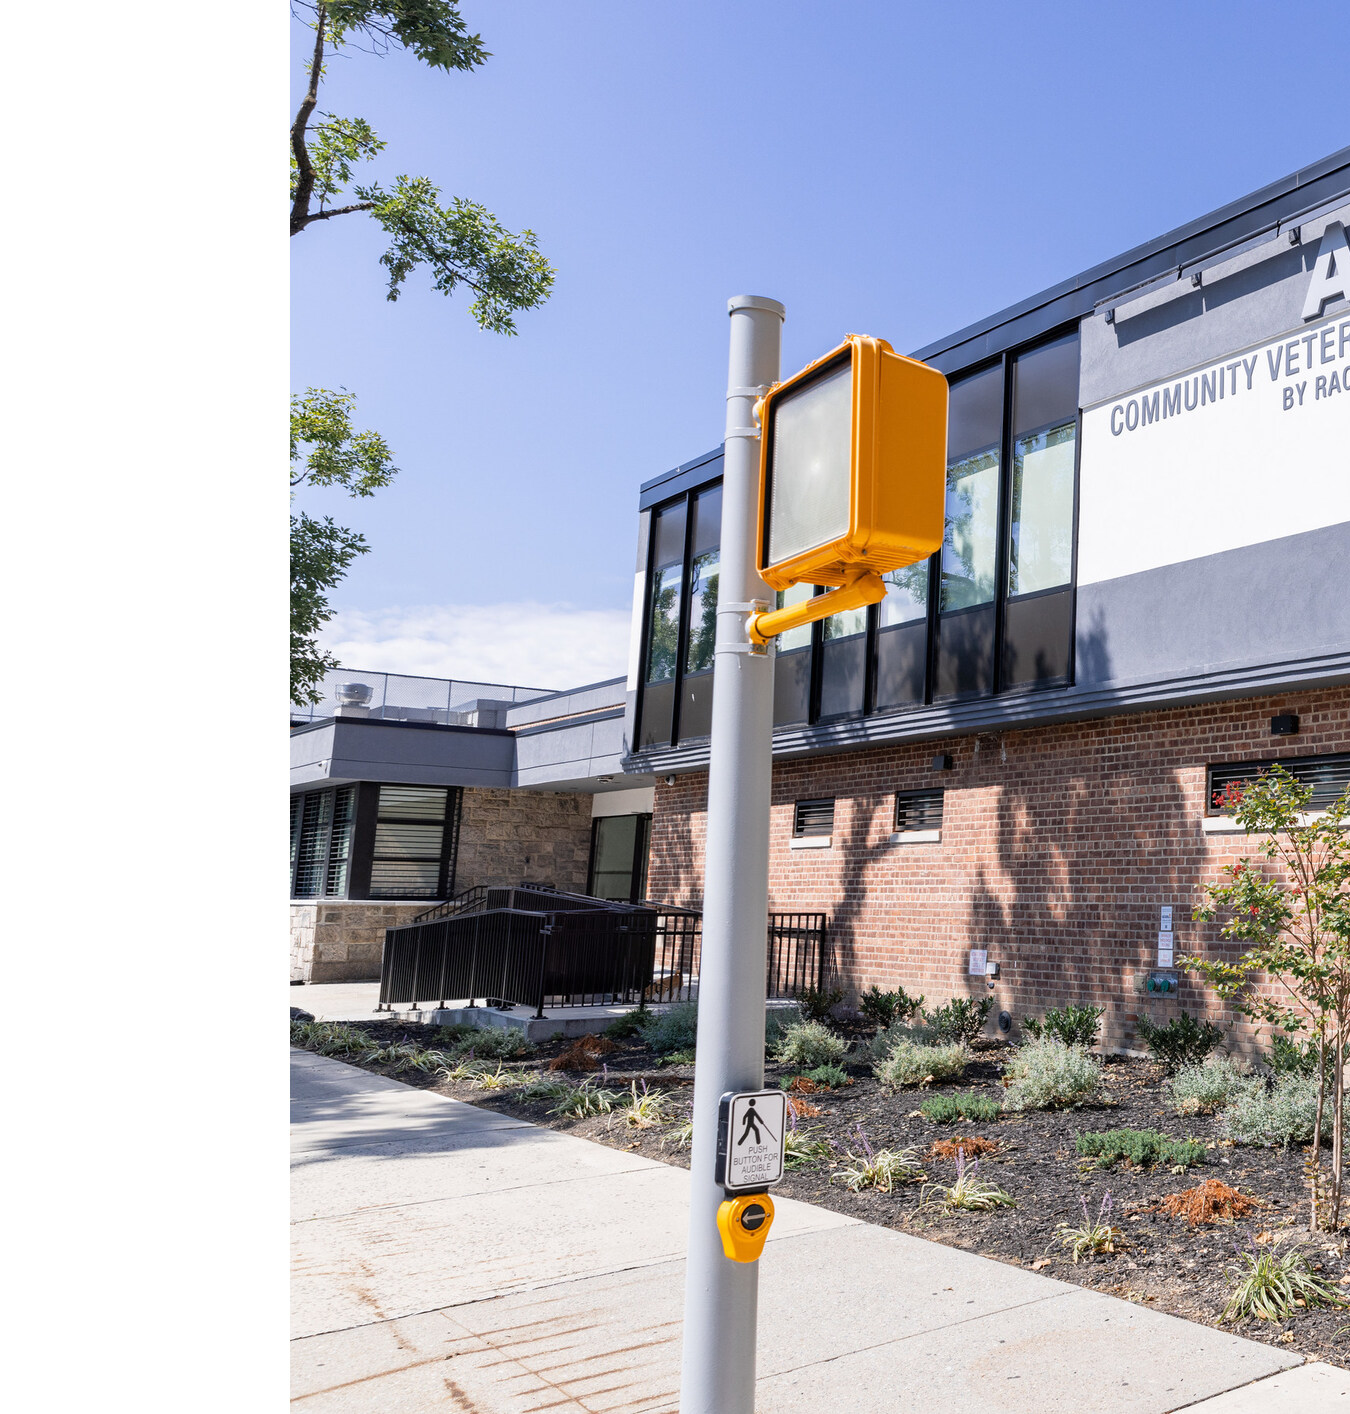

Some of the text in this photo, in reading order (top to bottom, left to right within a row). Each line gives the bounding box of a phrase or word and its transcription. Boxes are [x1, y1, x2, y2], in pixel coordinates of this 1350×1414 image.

[1110, 354, 1258, 437] COMMUNITY
[1282, 380, 1307, 411] BY
[748, 1145, 768, 1154] PUSH
[733, 1153, 779, 1166] BUTTON FOR
[741, 1163, 771, 1174] AUDIBLE
[743, 1173, 769, 1183] SIGNAL
